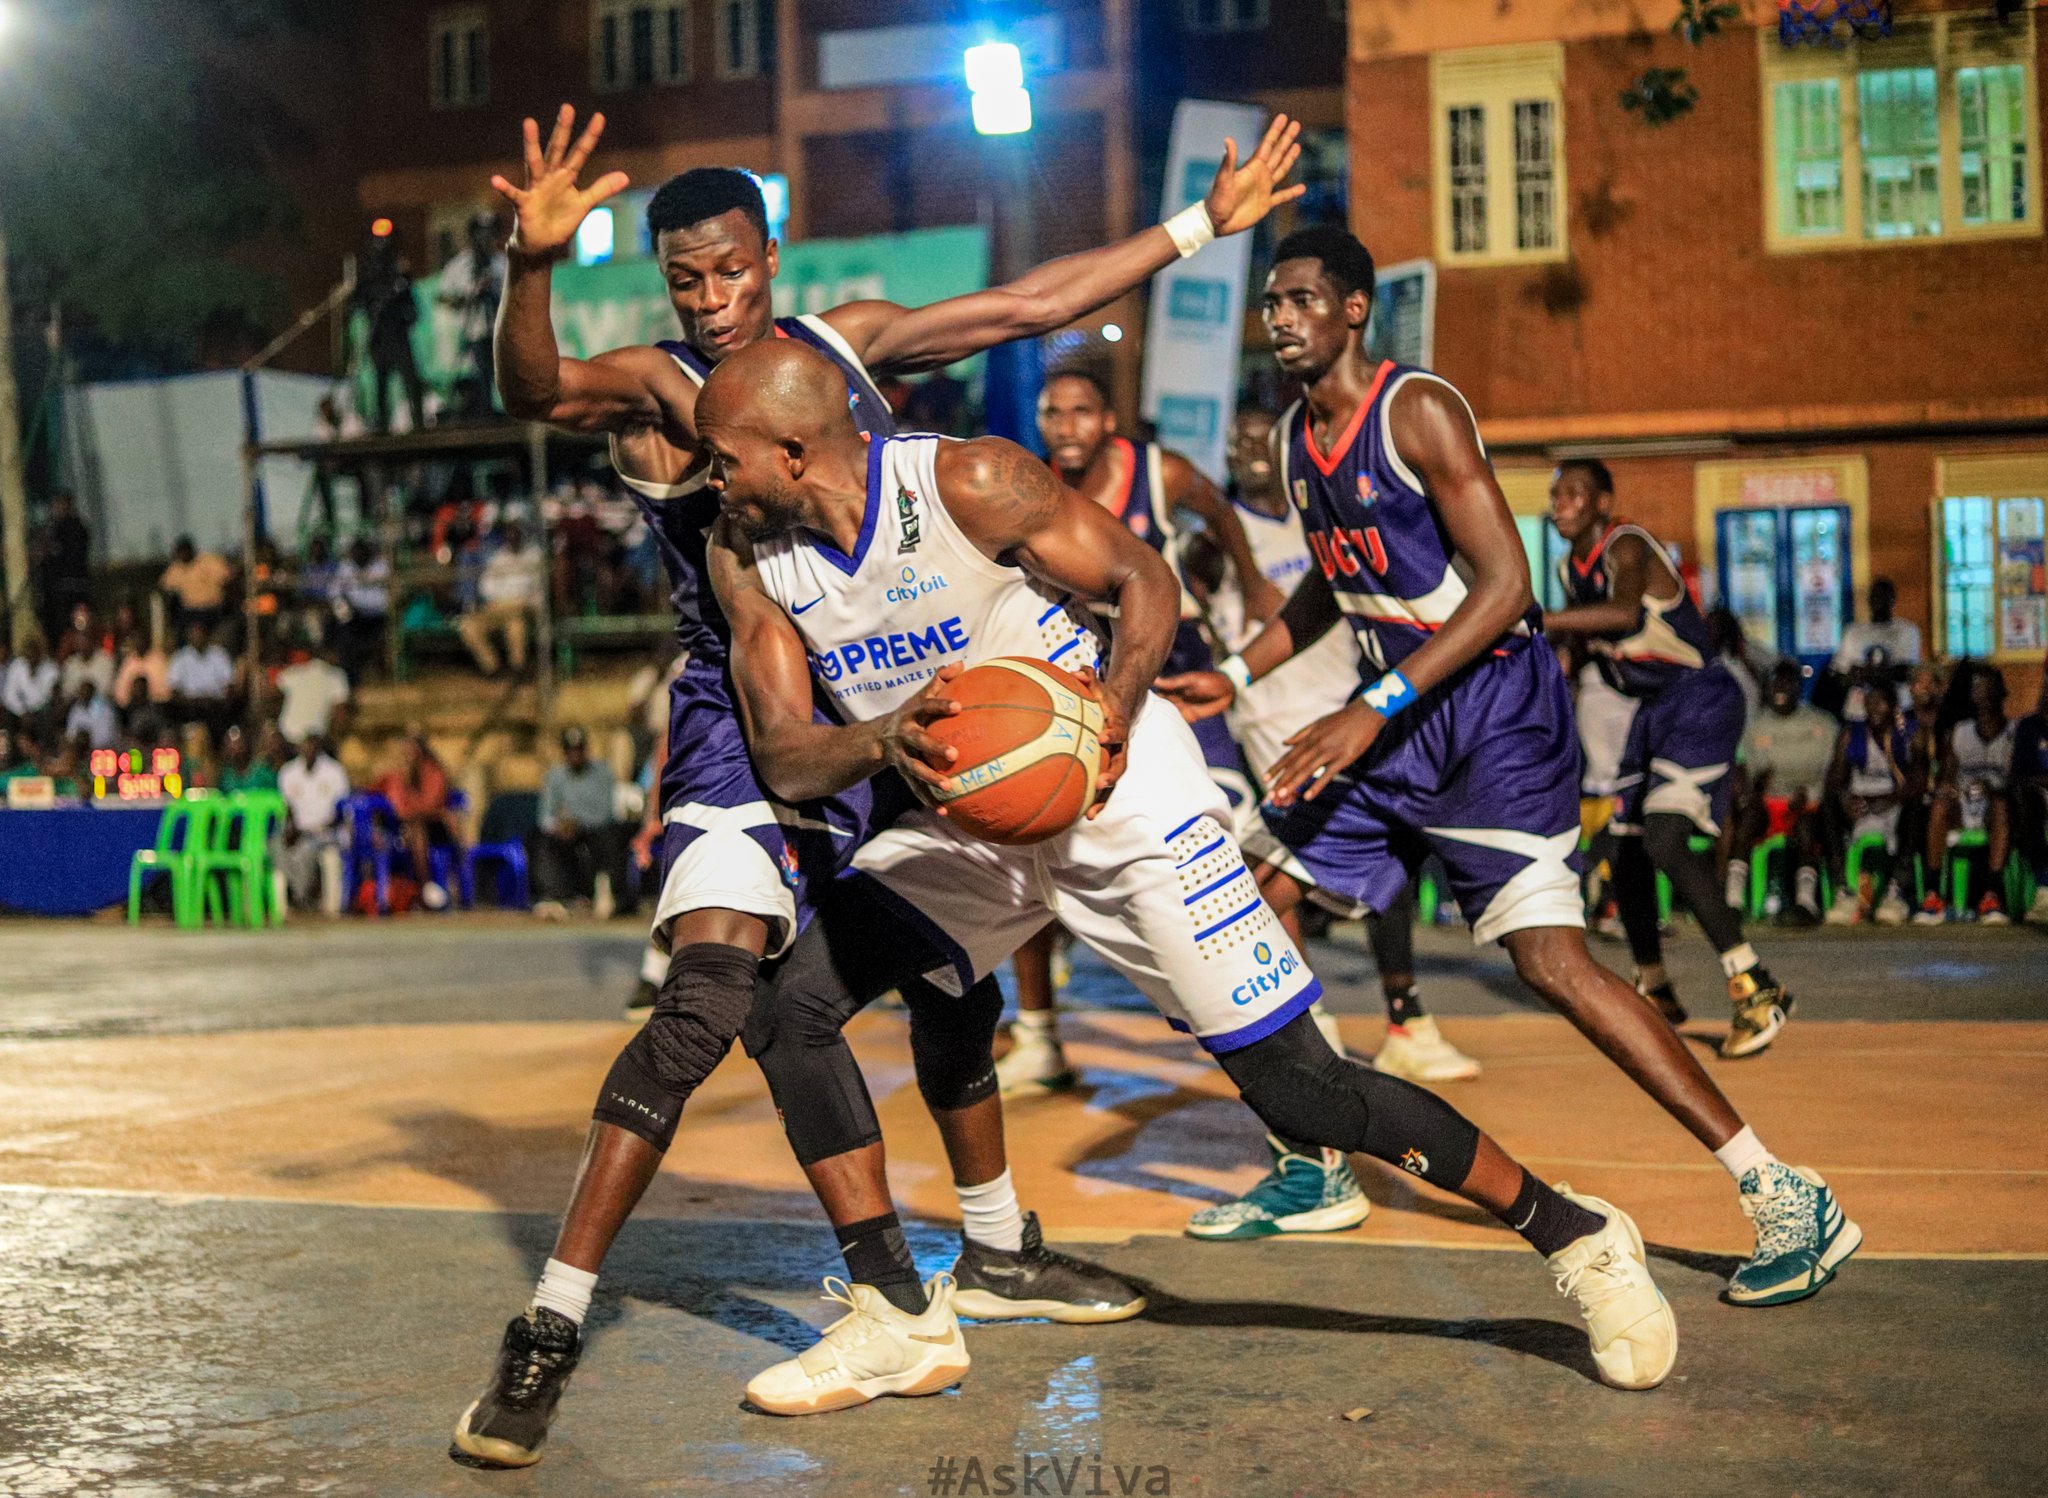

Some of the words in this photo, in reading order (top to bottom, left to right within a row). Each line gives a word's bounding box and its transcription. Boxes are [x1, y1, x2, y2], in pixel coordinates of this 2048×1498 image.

[1310, 526, 1389, 581] UCU
[886, 671, 924, 689] MAIZE
[611, 1092, 667, 1125] TARMAK
